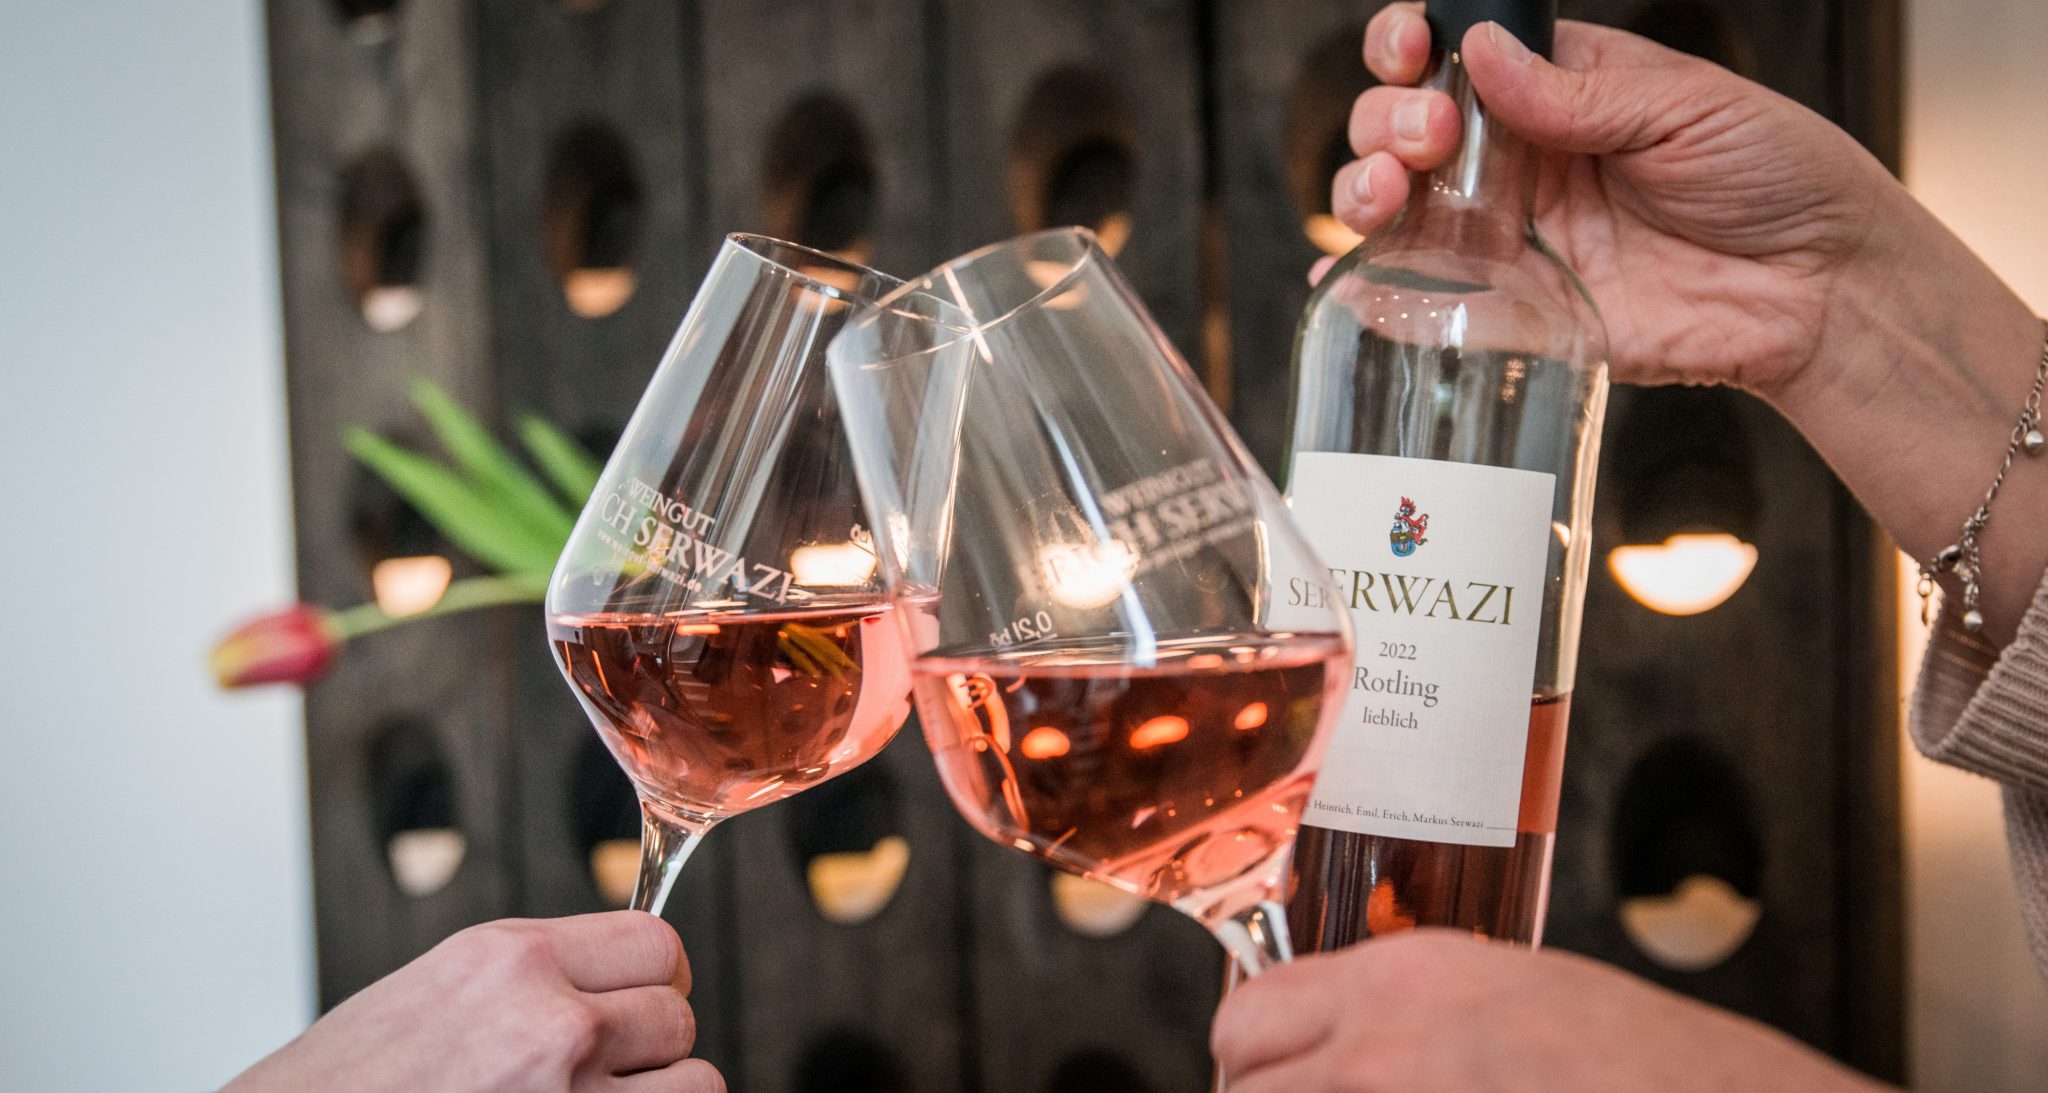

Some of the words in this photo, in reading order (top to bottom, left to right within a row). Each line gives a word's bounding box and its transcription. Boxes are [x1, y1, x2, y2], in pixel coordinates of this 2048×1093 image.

[628, 477, 716, 537] WEINGUT
[634, 515, 794, 606] SERWAZI
[1378, 641, 1417, 661] 2022
[1352, 666, 1440, 708] Rotling
[1362, 707, 1419, 730] lieblich
[1413, 812, 1448, 827] Markus
[1450, 815, 1484, 829] Serwazi
